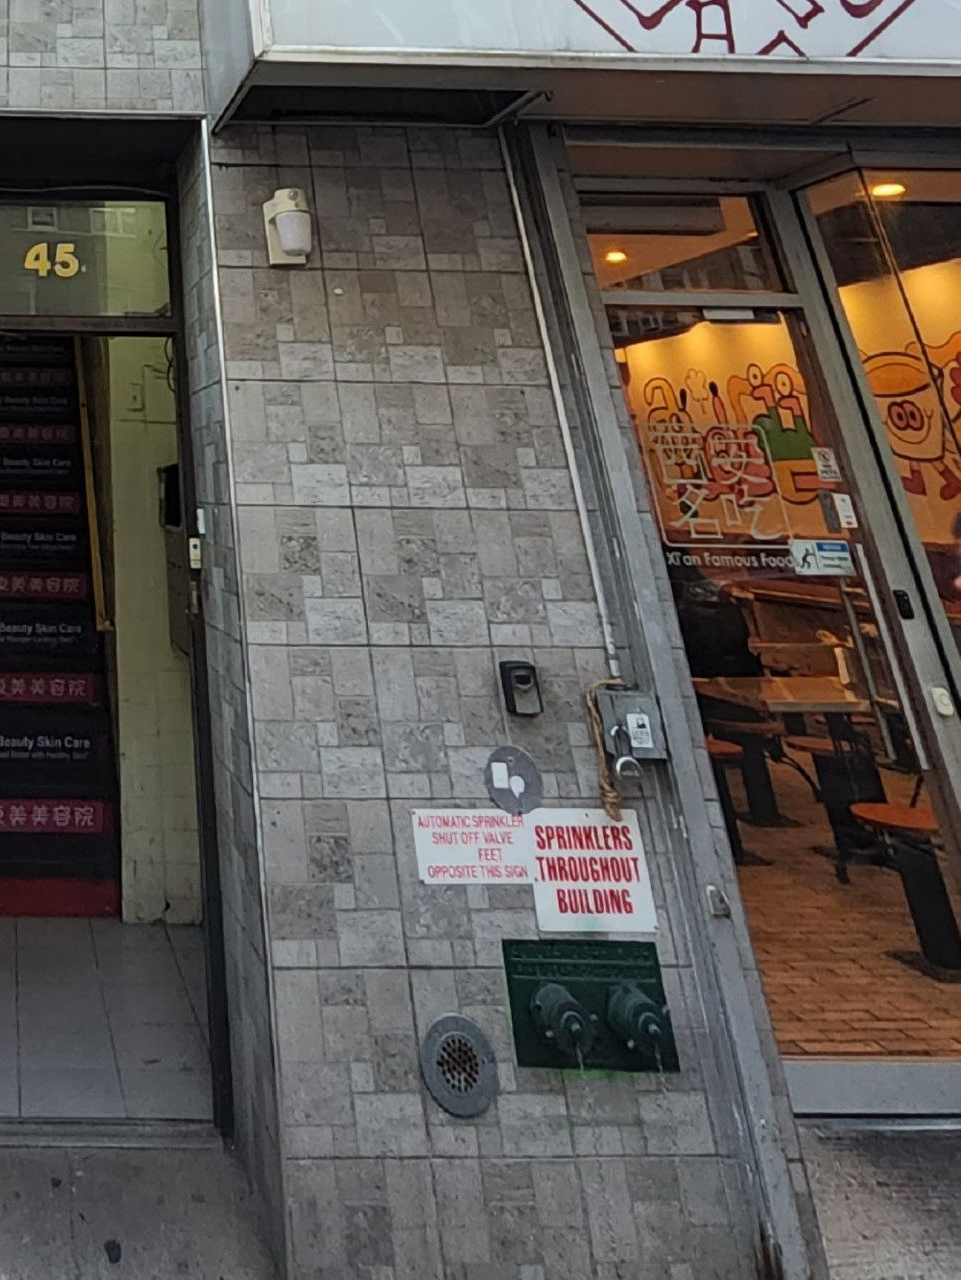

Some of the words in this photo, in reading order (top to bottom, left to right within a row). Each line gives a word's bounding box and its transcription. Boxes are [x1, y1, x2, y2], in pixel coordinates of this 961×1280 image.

[24, 242, 80, 277] 45
[37, 735, 62, 748] Skin
[64, 735, 90, 748] Care
[418, 815, 471, 828] AUTOMATIC
[472, 815, 524, 827] SPRINKLER
[432, 832, 458, 844] SHUT
[460, 832, 479, 844] OFF
[483, 832, 514, 844] VALVE
[535, 825, 633, 850] SPRINKLERS
[478, 848, 502, 861] FEET
[427, 865, 478, 878] OPPOSITE
[480, 865, 502, 878] THIS
[504, 865, 528, 878] SIGN
[536, 857, 641, 883] THROUGHOUT
[557, 888, 634, 914] BUILDING
